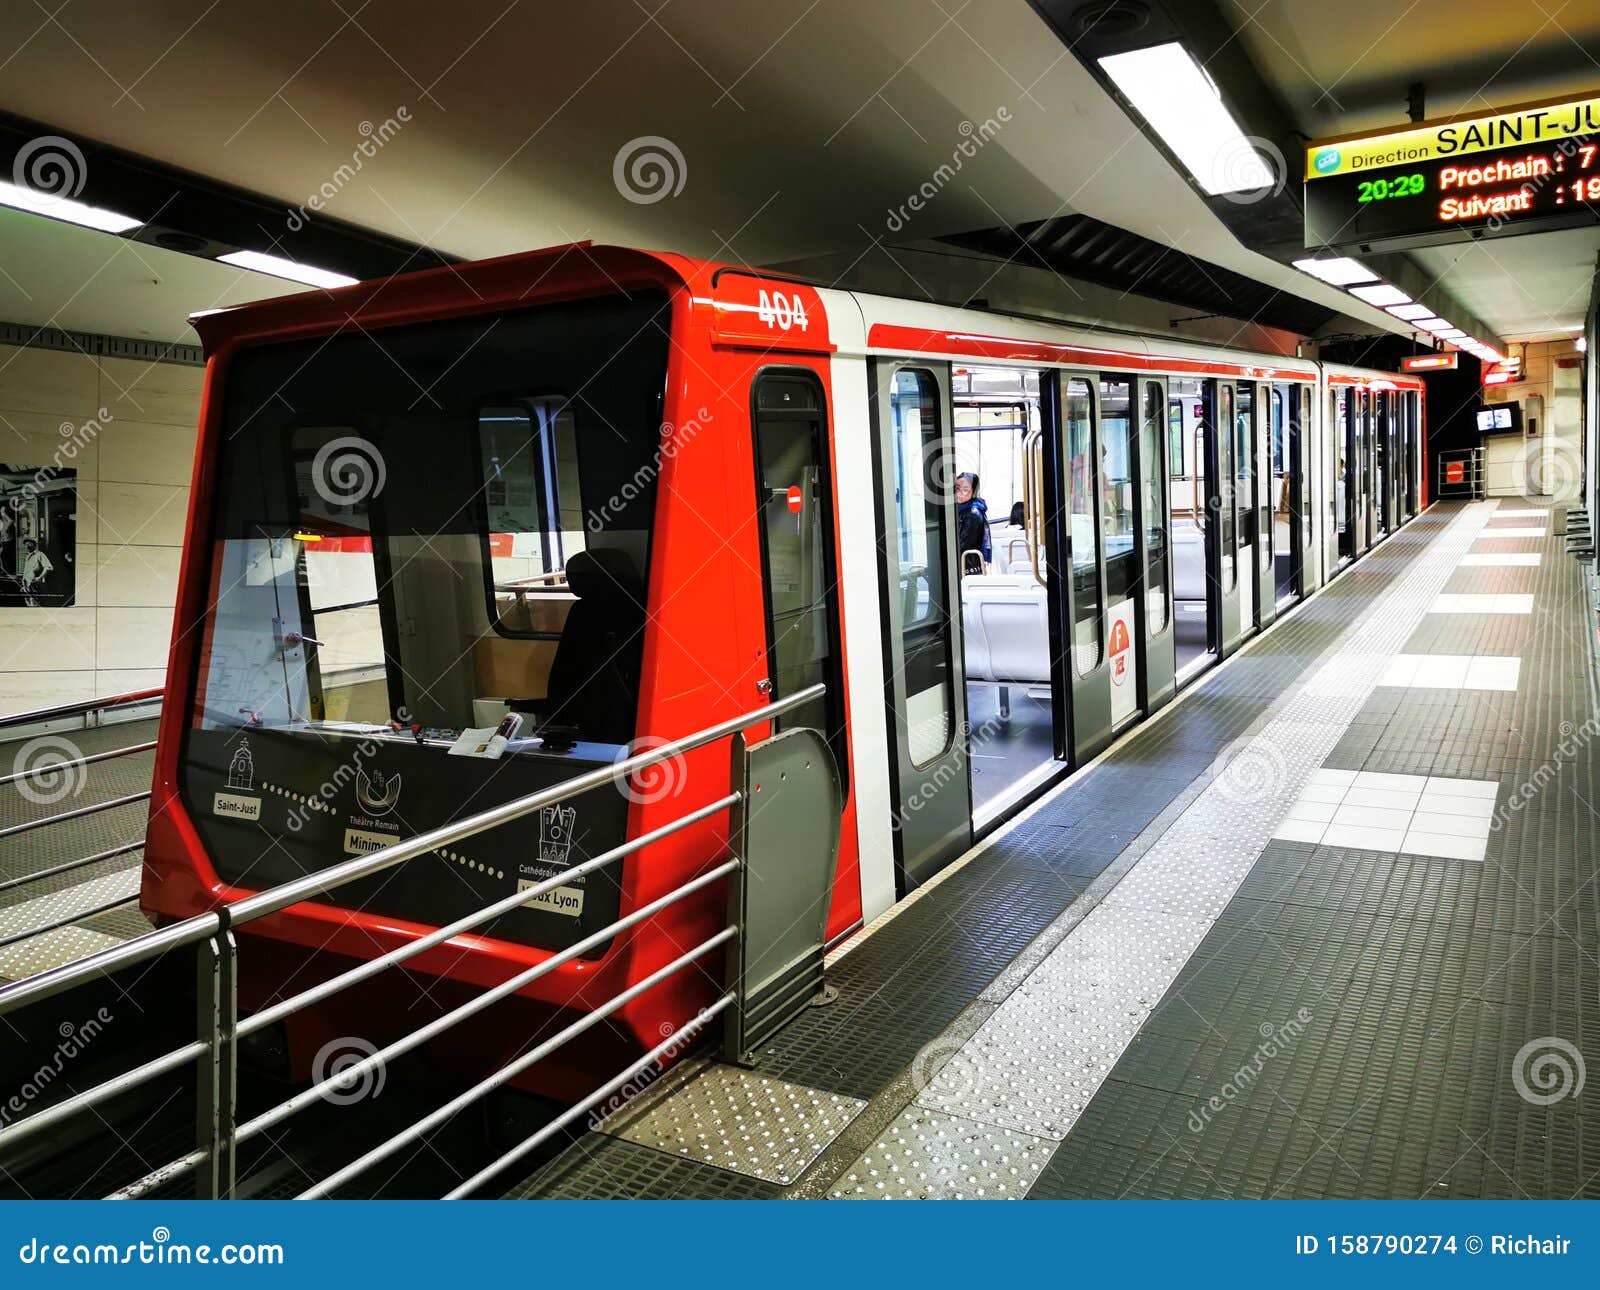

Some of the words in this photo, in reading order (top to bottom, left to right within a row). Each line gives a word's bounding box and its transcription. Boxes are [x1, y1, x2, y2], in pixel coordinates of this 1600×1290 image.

[1352, 147, 1429, 168] Direction
[1439, 155, 1549, 190] Prochain
[1579, 145, 1597, 169] 7
[1358, 174, 1425, 203] 20:29
[1439, 188, 1532, 221] Suivant
[758, 289, 809, 332] 404
[217, 799, 257, 815] Saint-Just
[374, 819, 399, 831] Romain
[553, 891, 579, 909] Lyon
